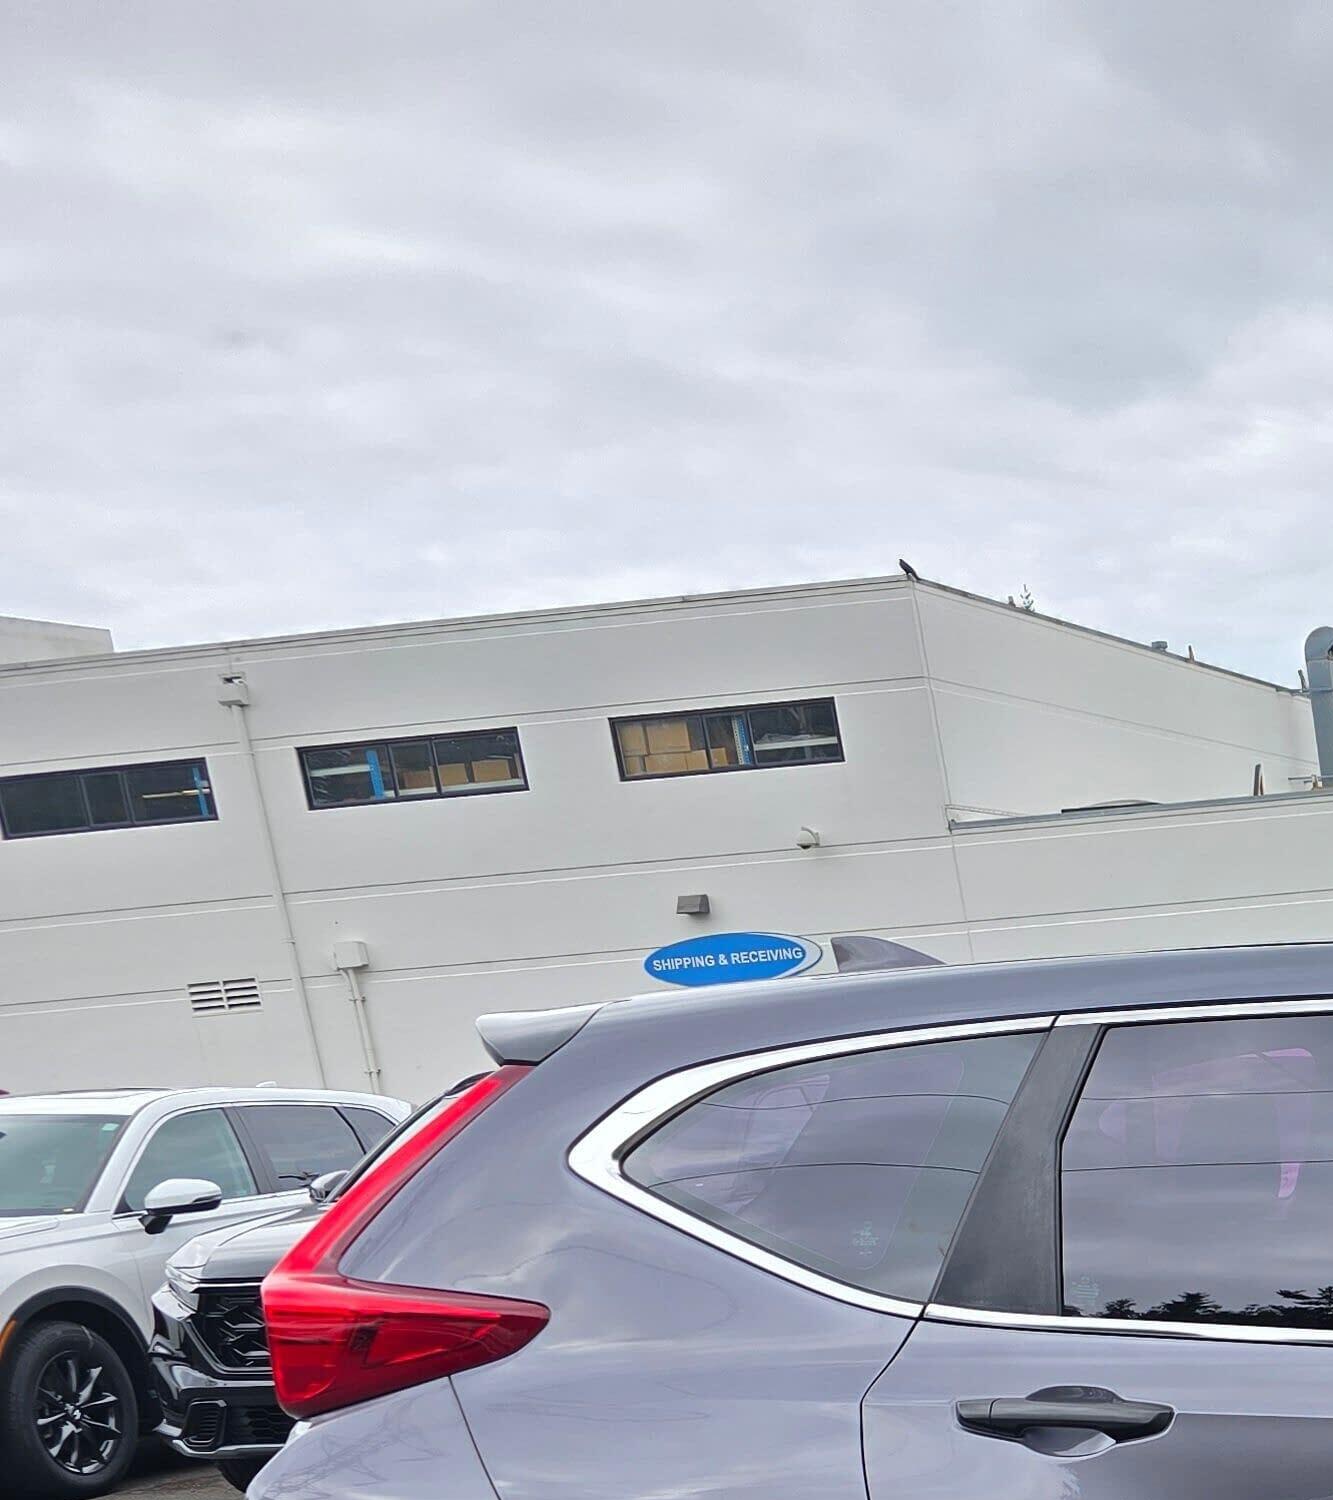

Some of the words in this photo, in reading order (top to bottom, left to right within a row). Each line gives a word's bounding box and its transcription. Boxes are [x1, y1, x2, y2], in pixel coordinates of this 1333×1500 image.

[653, 954, 715, 971] SHIPPING
[718, 953, 728, 966] &
[731, 947, 803, 965] RECEIVING
